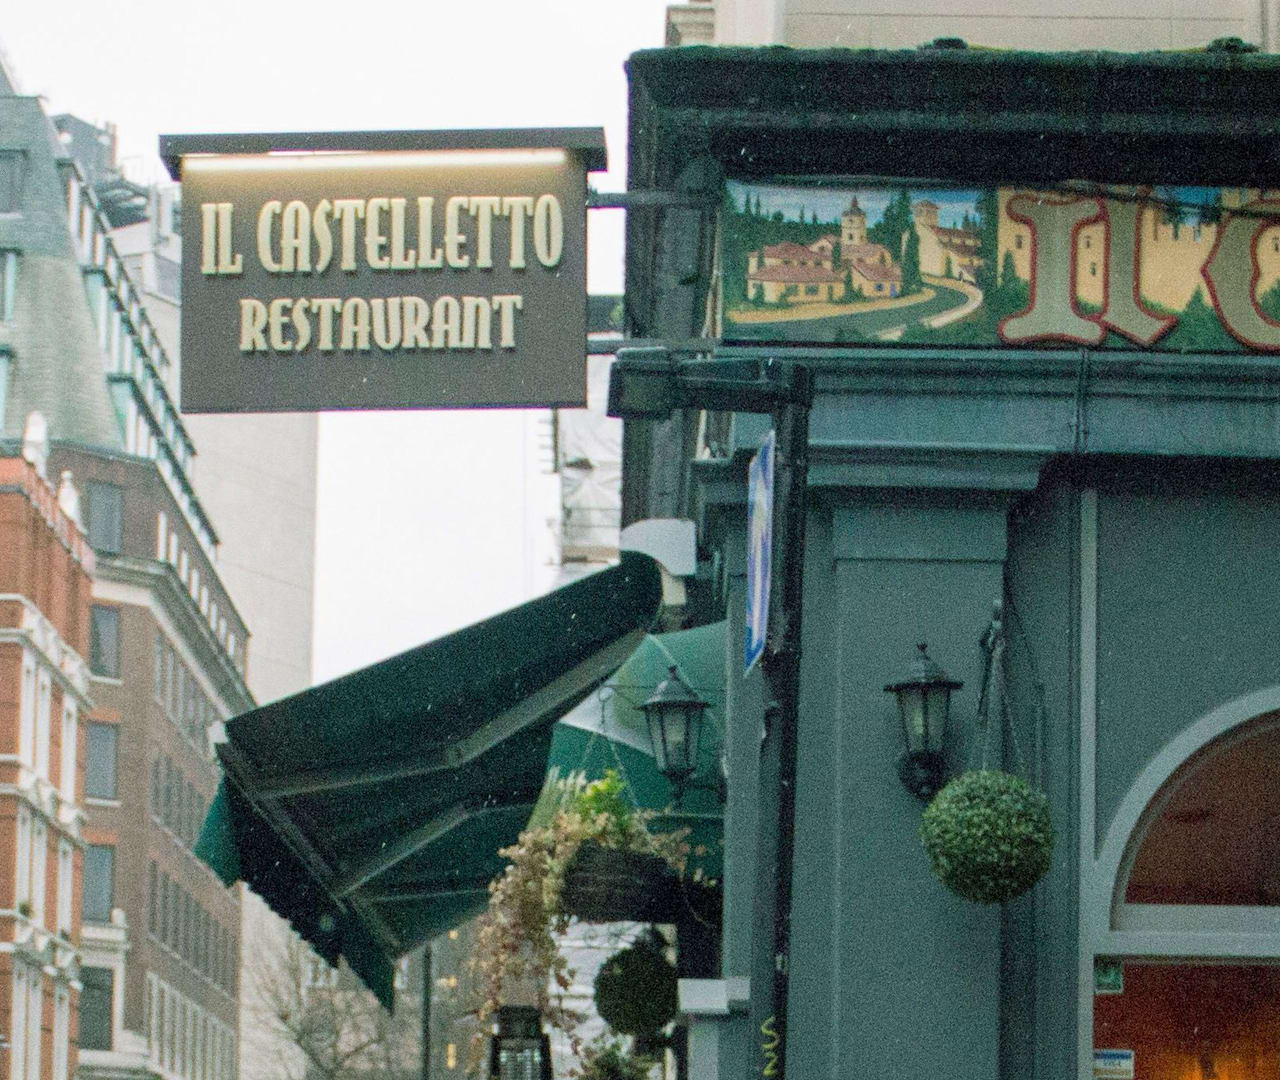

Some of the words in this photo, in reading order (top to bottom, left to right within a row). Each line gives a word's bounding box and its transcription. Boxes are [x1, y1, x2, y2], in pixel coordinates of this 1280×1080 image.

[201, 203, 243, 274] IL
[257, 194, 564, 272] CASTELLETTO
[998, 190, 1179, 348] Il
[239, 295, 522, 351] RESTAURANT
